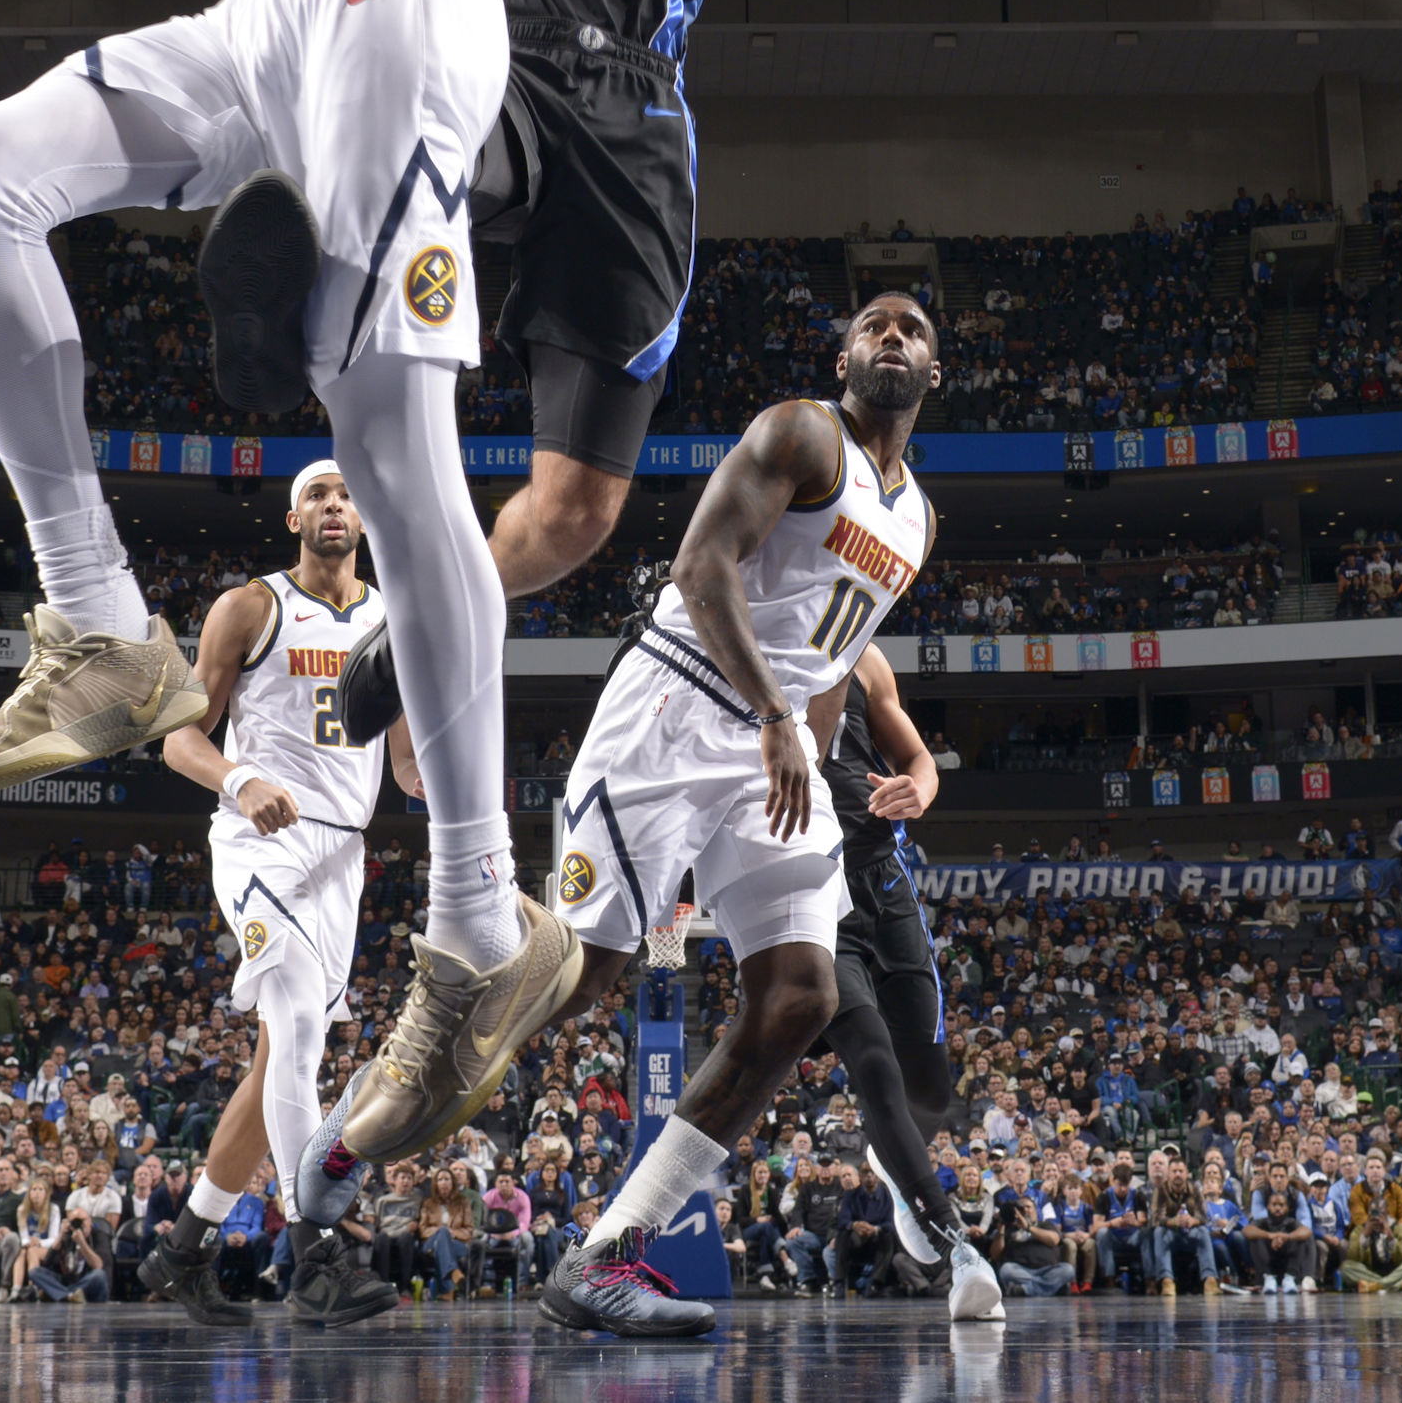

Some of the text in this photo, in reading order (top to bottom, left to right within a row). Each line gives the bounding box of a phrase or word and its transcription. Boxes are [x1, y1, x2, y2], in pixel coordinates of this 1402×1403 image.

[650, 447, 680, 464] THE
[808, 576, 877, 663] 10
[315, 685, 367, 749] 2
[912, 865, 1337, 900] WDY, PROUD & LOUD!
[648, 1053, 671, 1073] GET
[648, 1074, 671, 1094] THE
[654, 1094, 677, 1119] App
